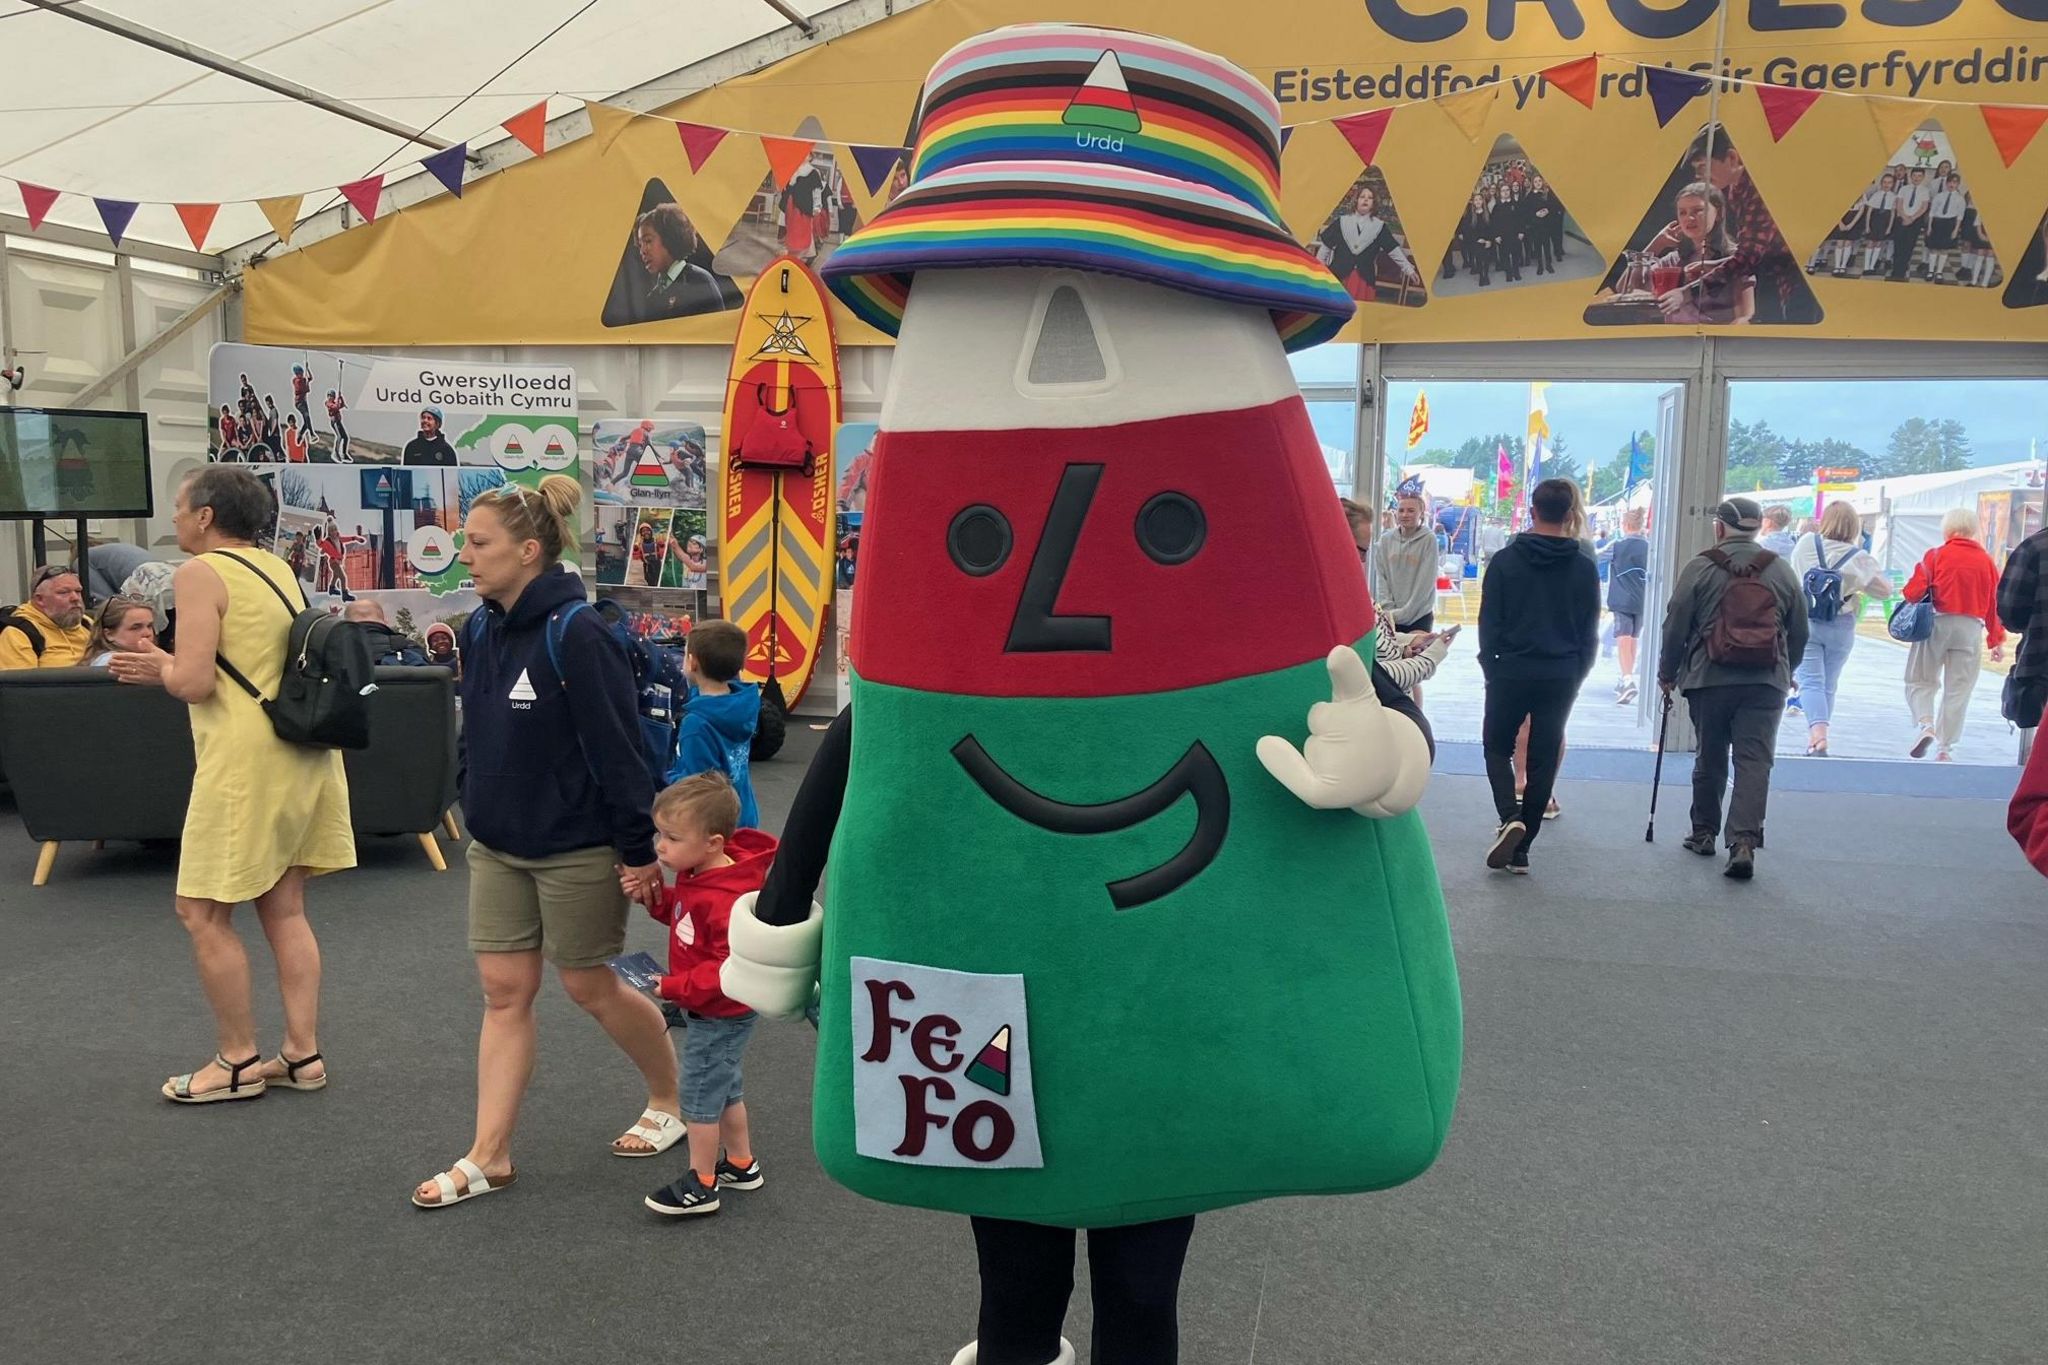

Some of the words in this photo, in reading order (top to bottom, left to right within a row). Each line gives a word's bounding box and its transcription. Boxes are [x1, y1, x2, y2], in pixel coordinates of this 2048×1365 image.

[1076, 131, 1124, 153] Urdd
[419, 371, 571, 392] Gwersylloedd
[376, 388, 422, 403] Urdd
[429, 390, 504, 406] Gobaith
[511, 393, 571, 409] Cymru
[630, 488, 671, 499] Glan-llyn
[511, 700, 531, 710] Urdd
